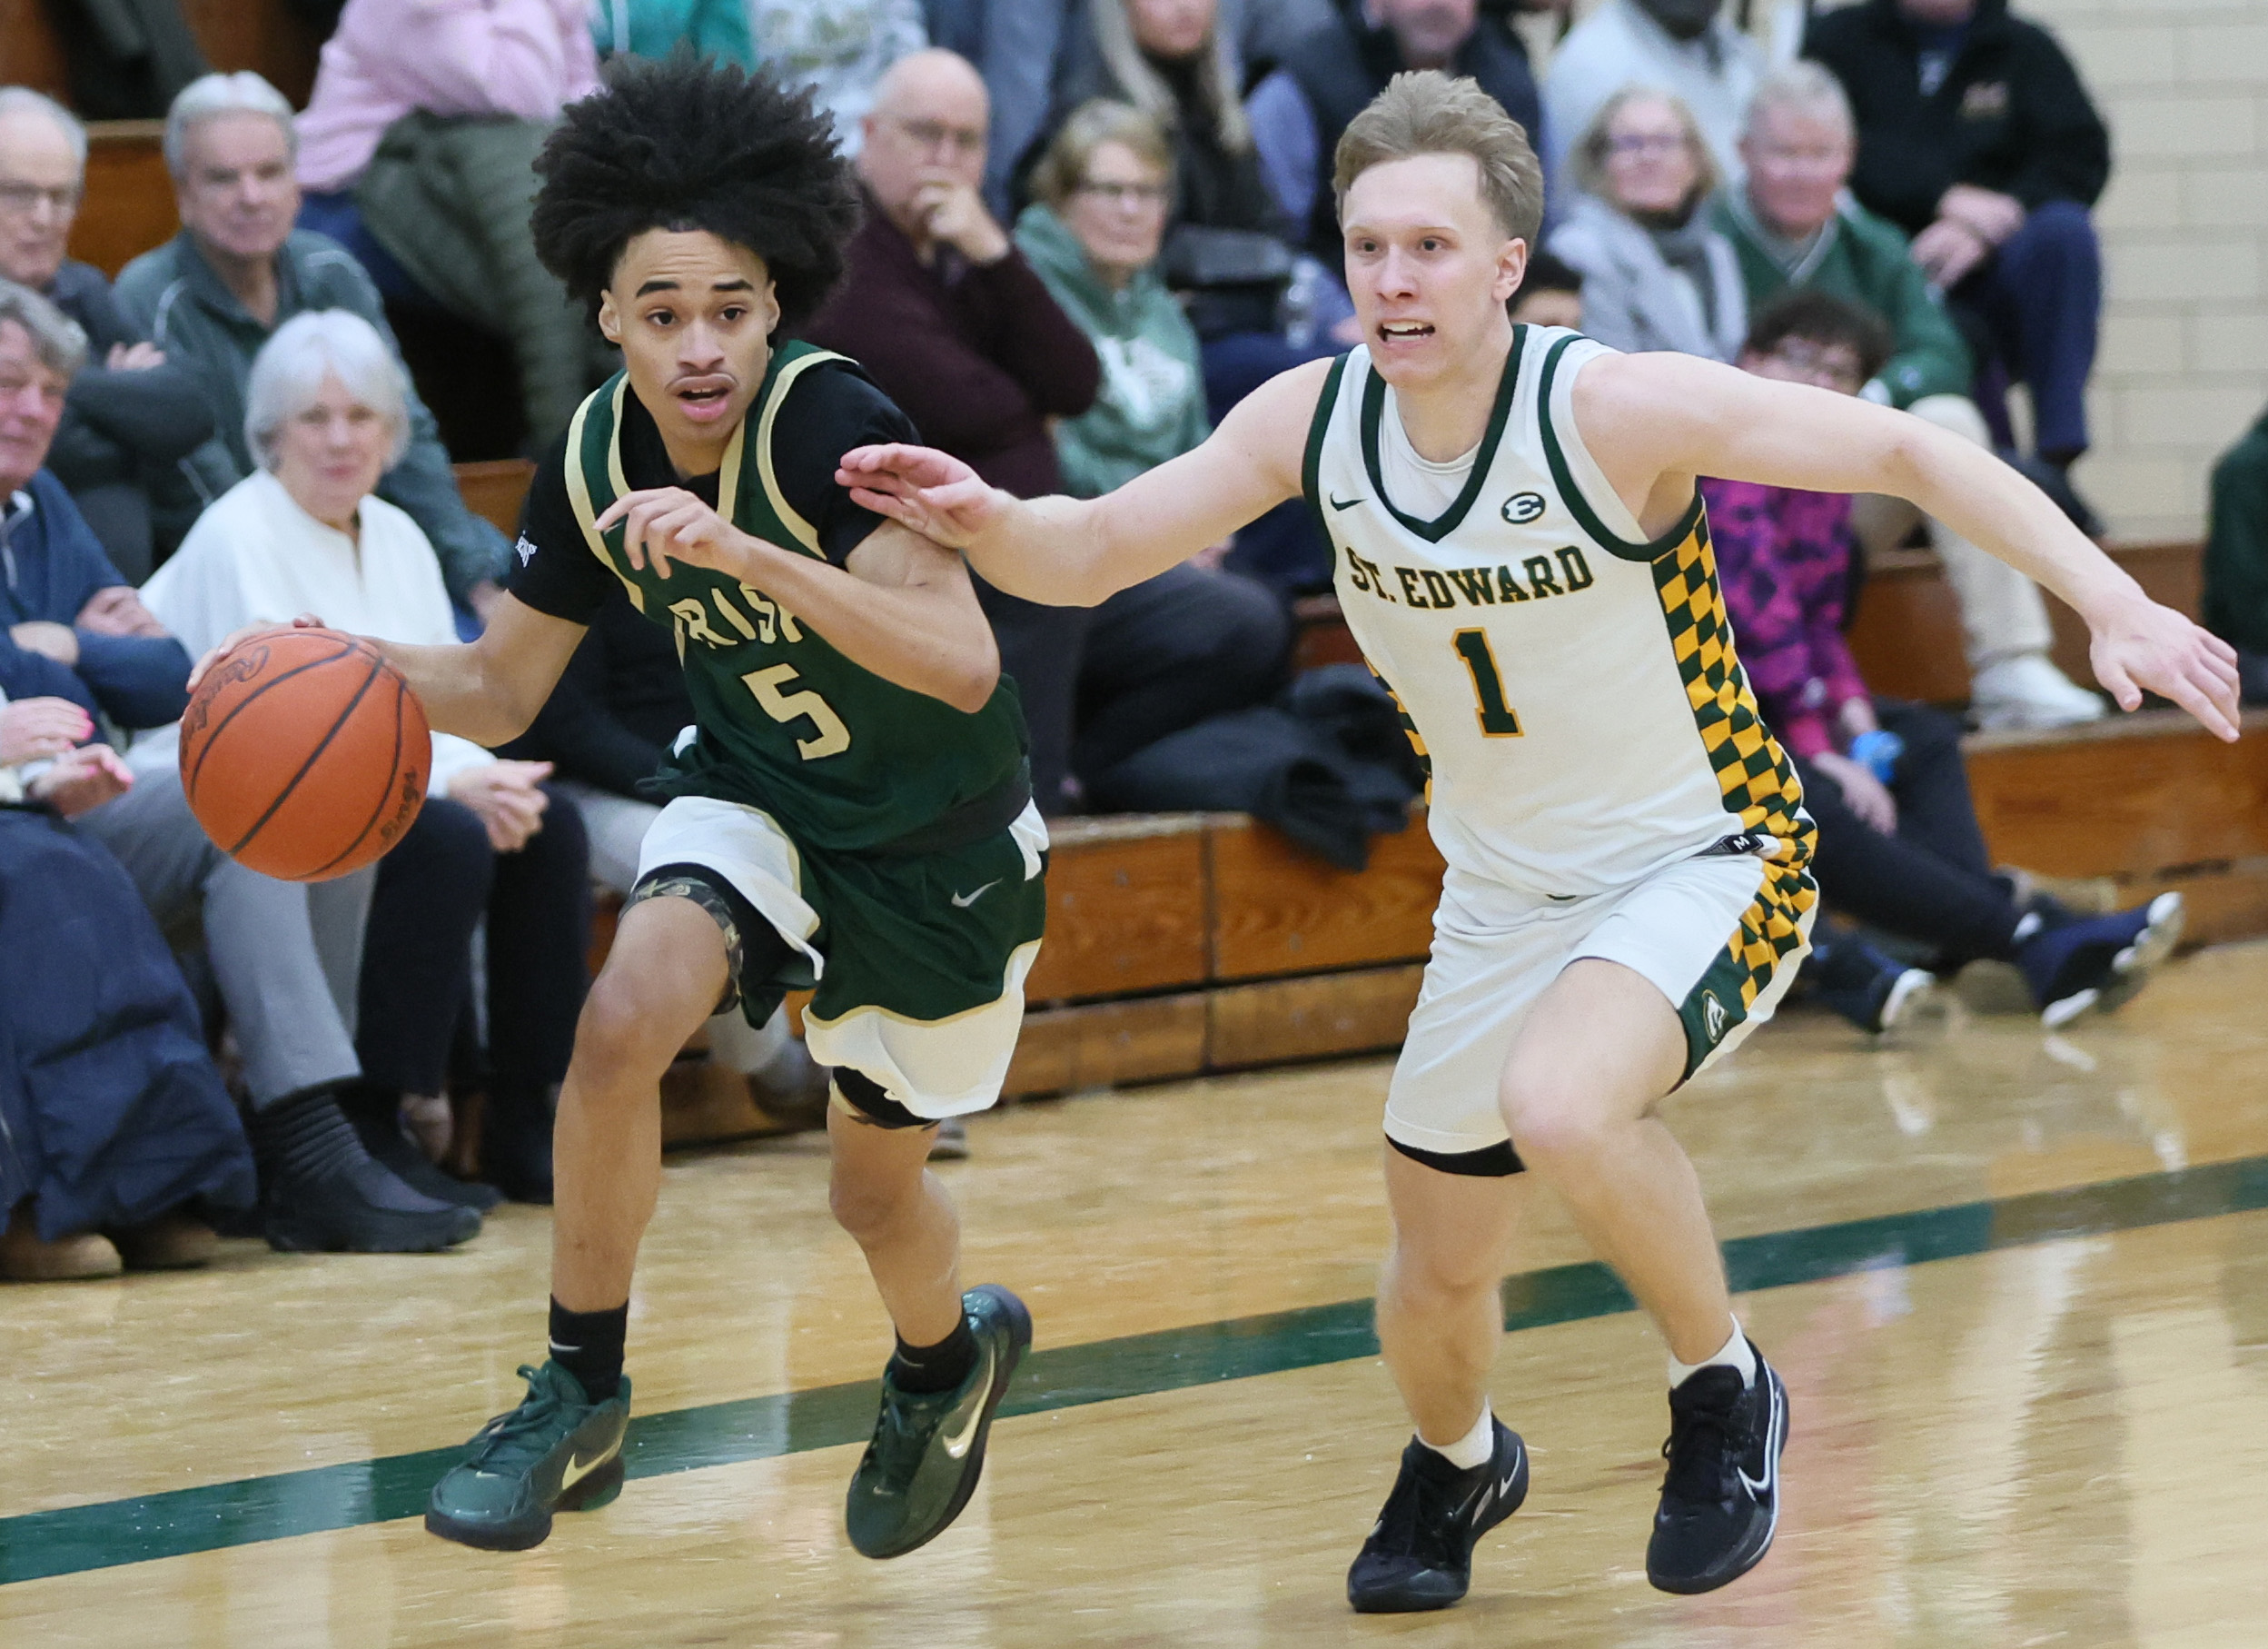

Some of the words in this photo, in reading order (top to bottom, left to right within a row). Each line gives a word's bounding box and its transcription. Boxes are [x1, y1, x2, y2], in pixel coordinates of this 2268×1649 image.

[1345, 546, 1396, 603] ST.
[1394, 545, 1594, 609] EDWARD
[740, 663, 851, 760] 5
[1451, 627, 1524, 738] 1
[1733, 835, 1750, 850] M
